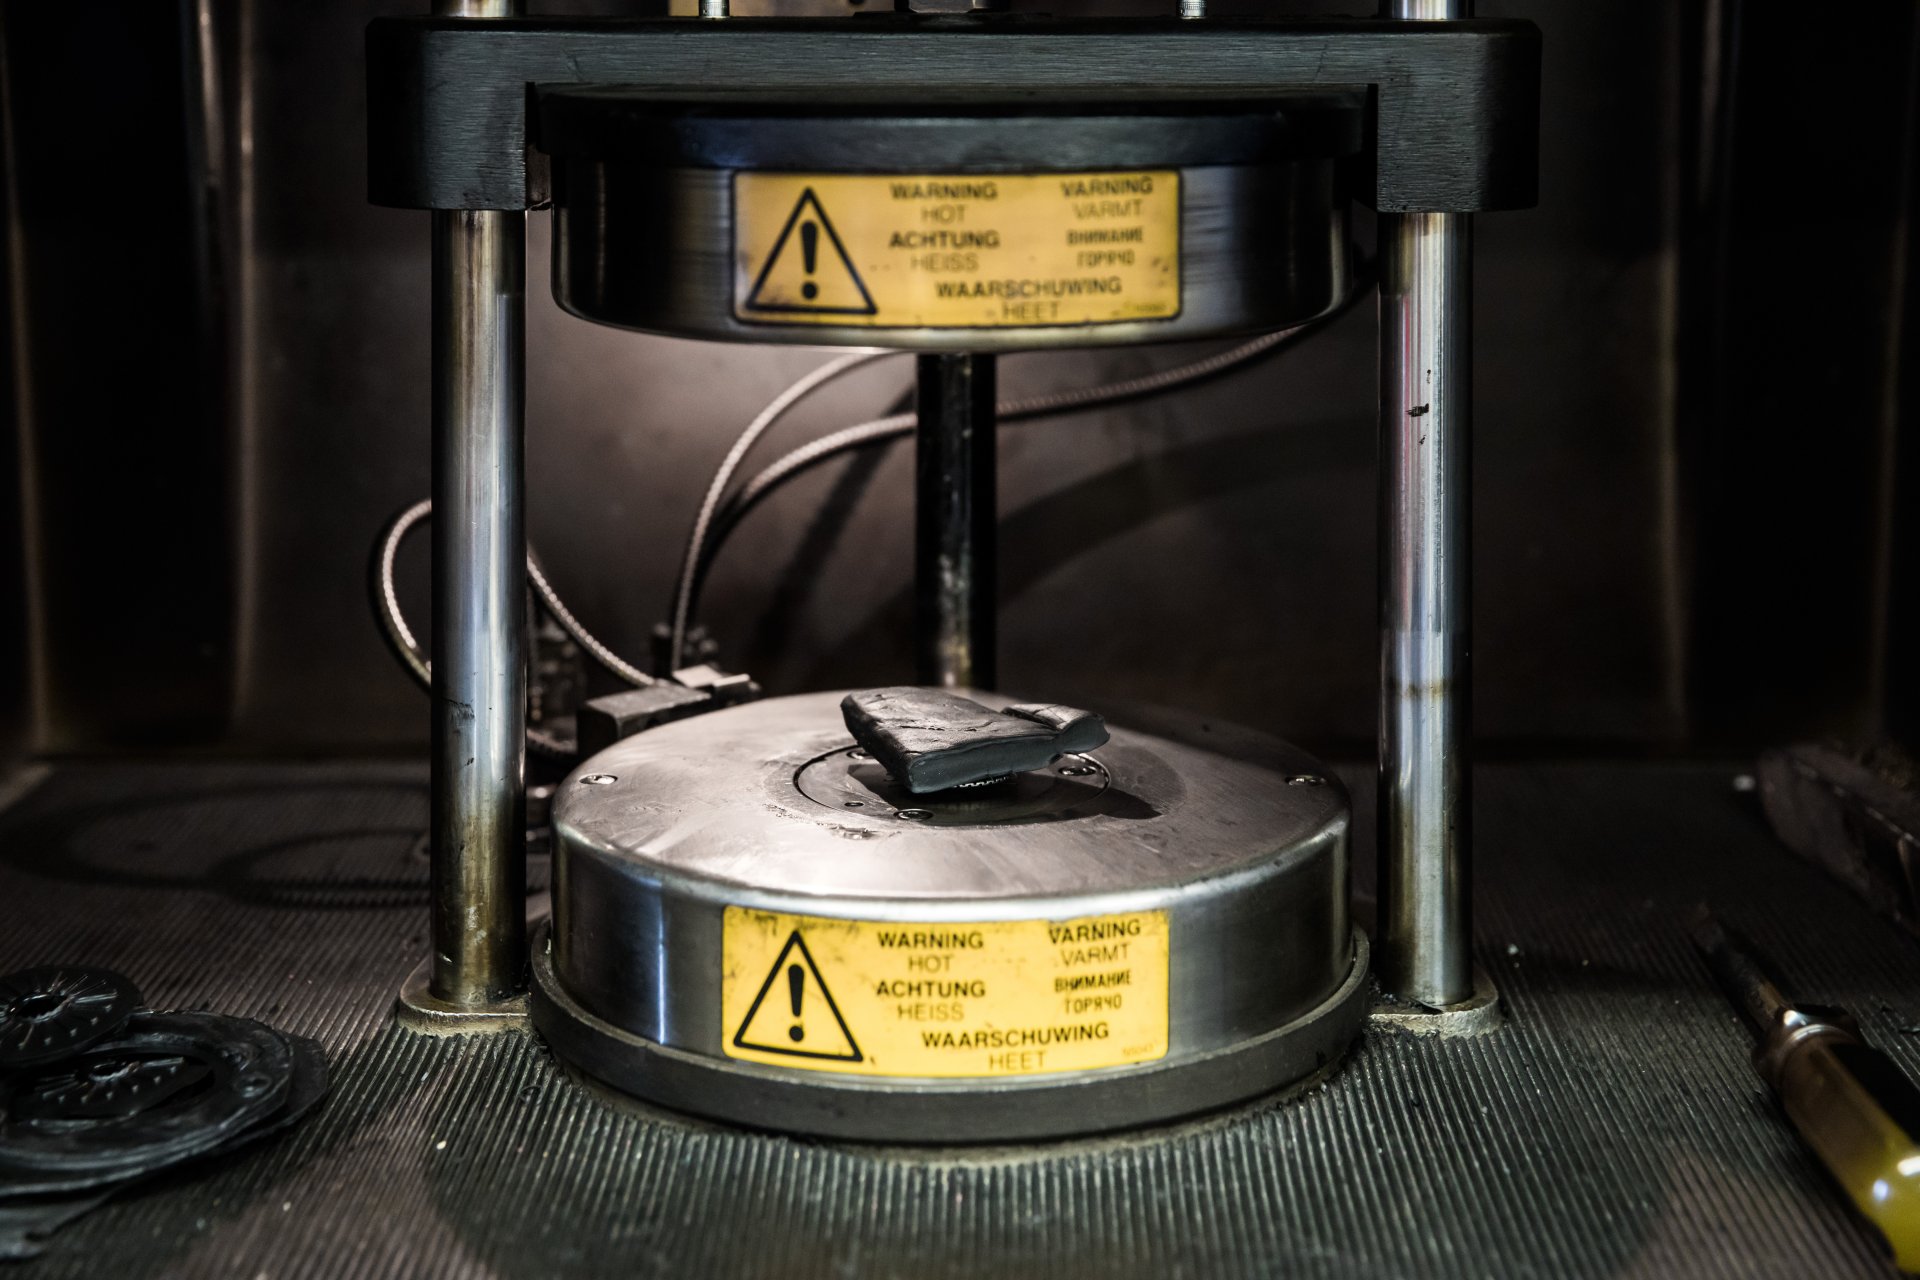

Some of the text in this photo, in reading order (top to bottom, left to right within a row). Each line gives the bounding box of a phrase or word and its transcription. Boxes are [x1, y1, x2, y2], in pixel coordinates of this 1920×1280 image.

[890, 182, 998, 200] WARNING
[1061, 177, 1153, 197] VARNING
[921, 205, 968, 224] HOT
[1073, 200, 1143, 219] VARMT
[889, 231, 1000, 248] ACHTUNG
[911, 254, 978, 272] HEISS
[935, 277, 1122, 298] WAARSCHUWING
[1002, 302, 1061, 320] HEET
[878, 932, 983, 949] WARNING
[1049, 920, 1141, 945] VARNING
[1061, 943, 1130, 967] VARMT
[908, 956, 953, 973] HOT
[876, 981, 985, 997] ACHTUNG
[1054, 970, 1131, 993] ВНИМАНИЕ
[897, 1004, 965, 1021] HEISS
[1064, 994, 1122, 1014] ГОРЯЧО
[923, 1023, 1109, 1048] WAARSCHUWING
[988, 1052, 1046, 1070] HEET
